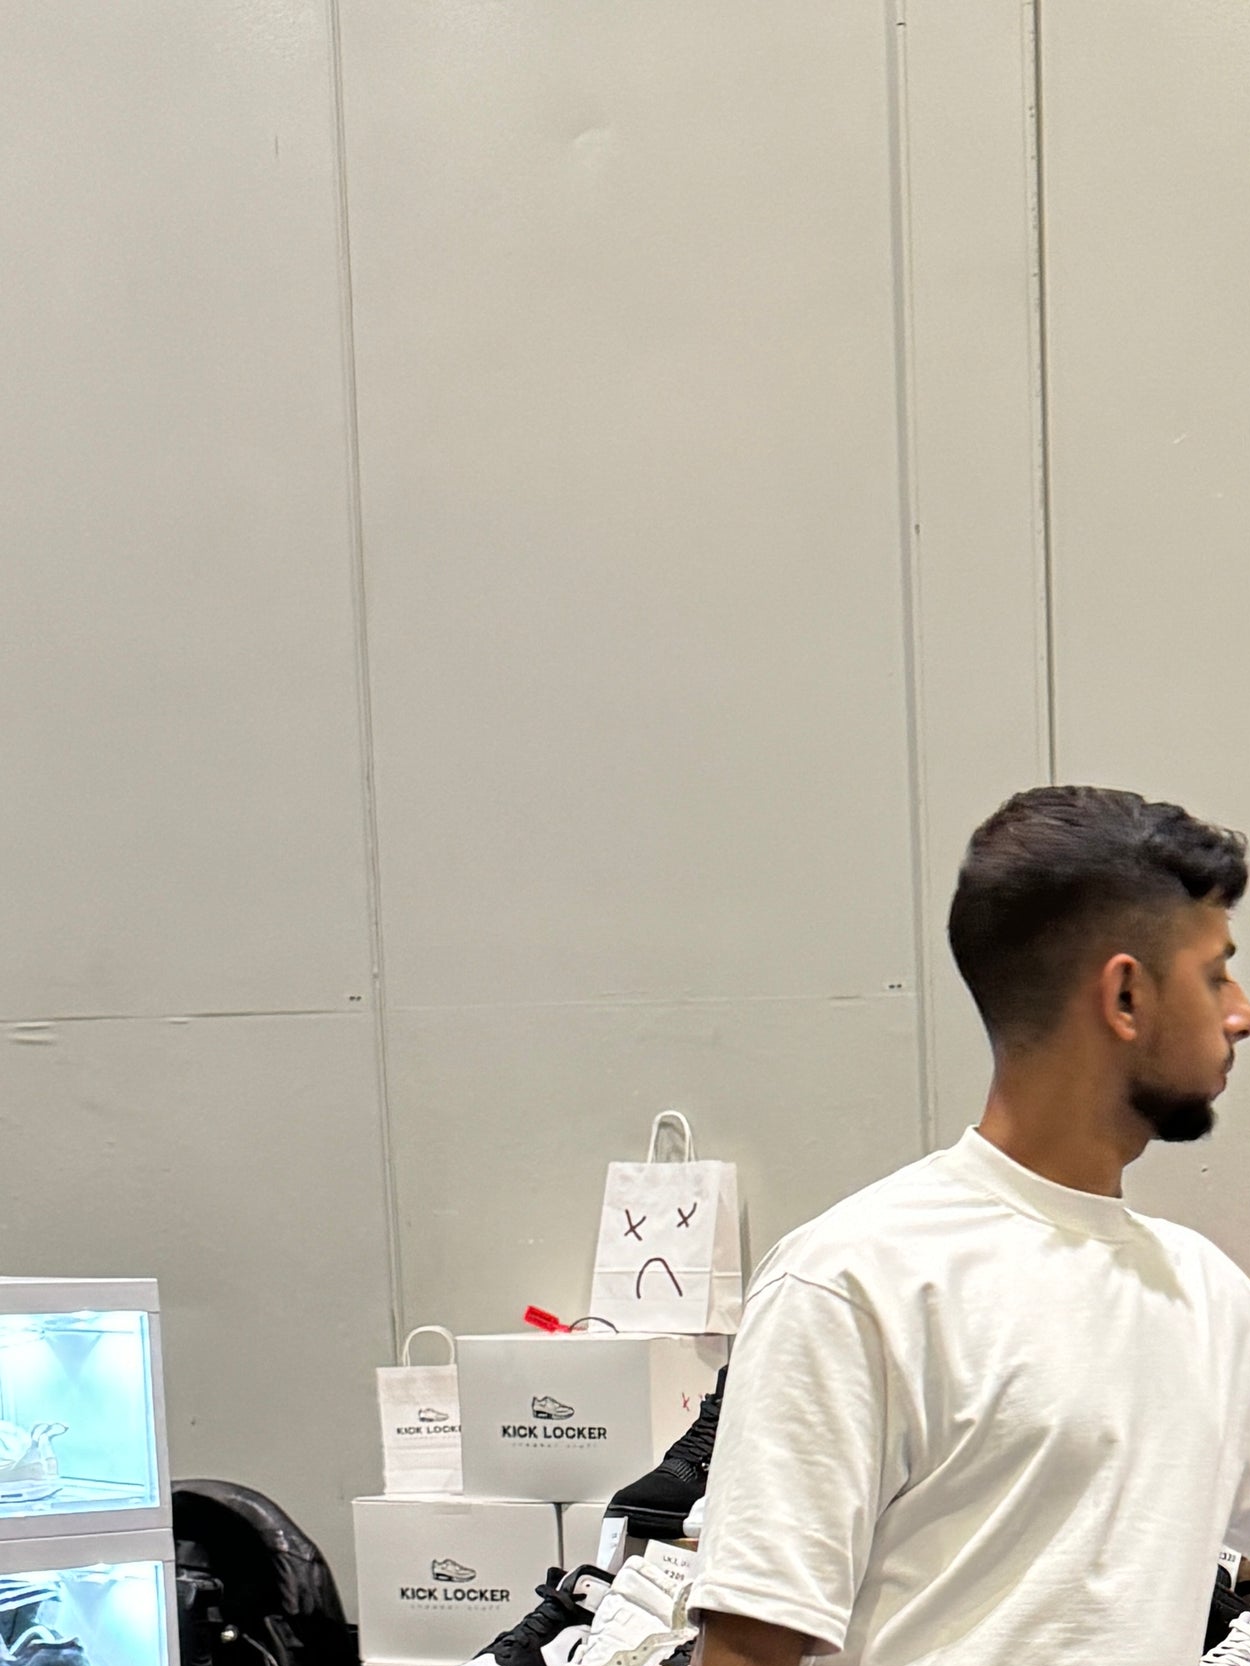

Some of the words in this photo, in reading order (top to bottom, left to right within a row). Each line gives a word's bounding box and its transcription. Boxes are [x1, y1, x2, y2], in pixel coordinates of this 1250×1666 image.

[397, 1426, 423, 1436] KICK
[502, 1425, 538, 1439] KICK
[543, 1425, 608, 1440] LOCKER
[400, 1586, 438, 1601] KICK
[444, 1587, 511, 1602] LOCKER
